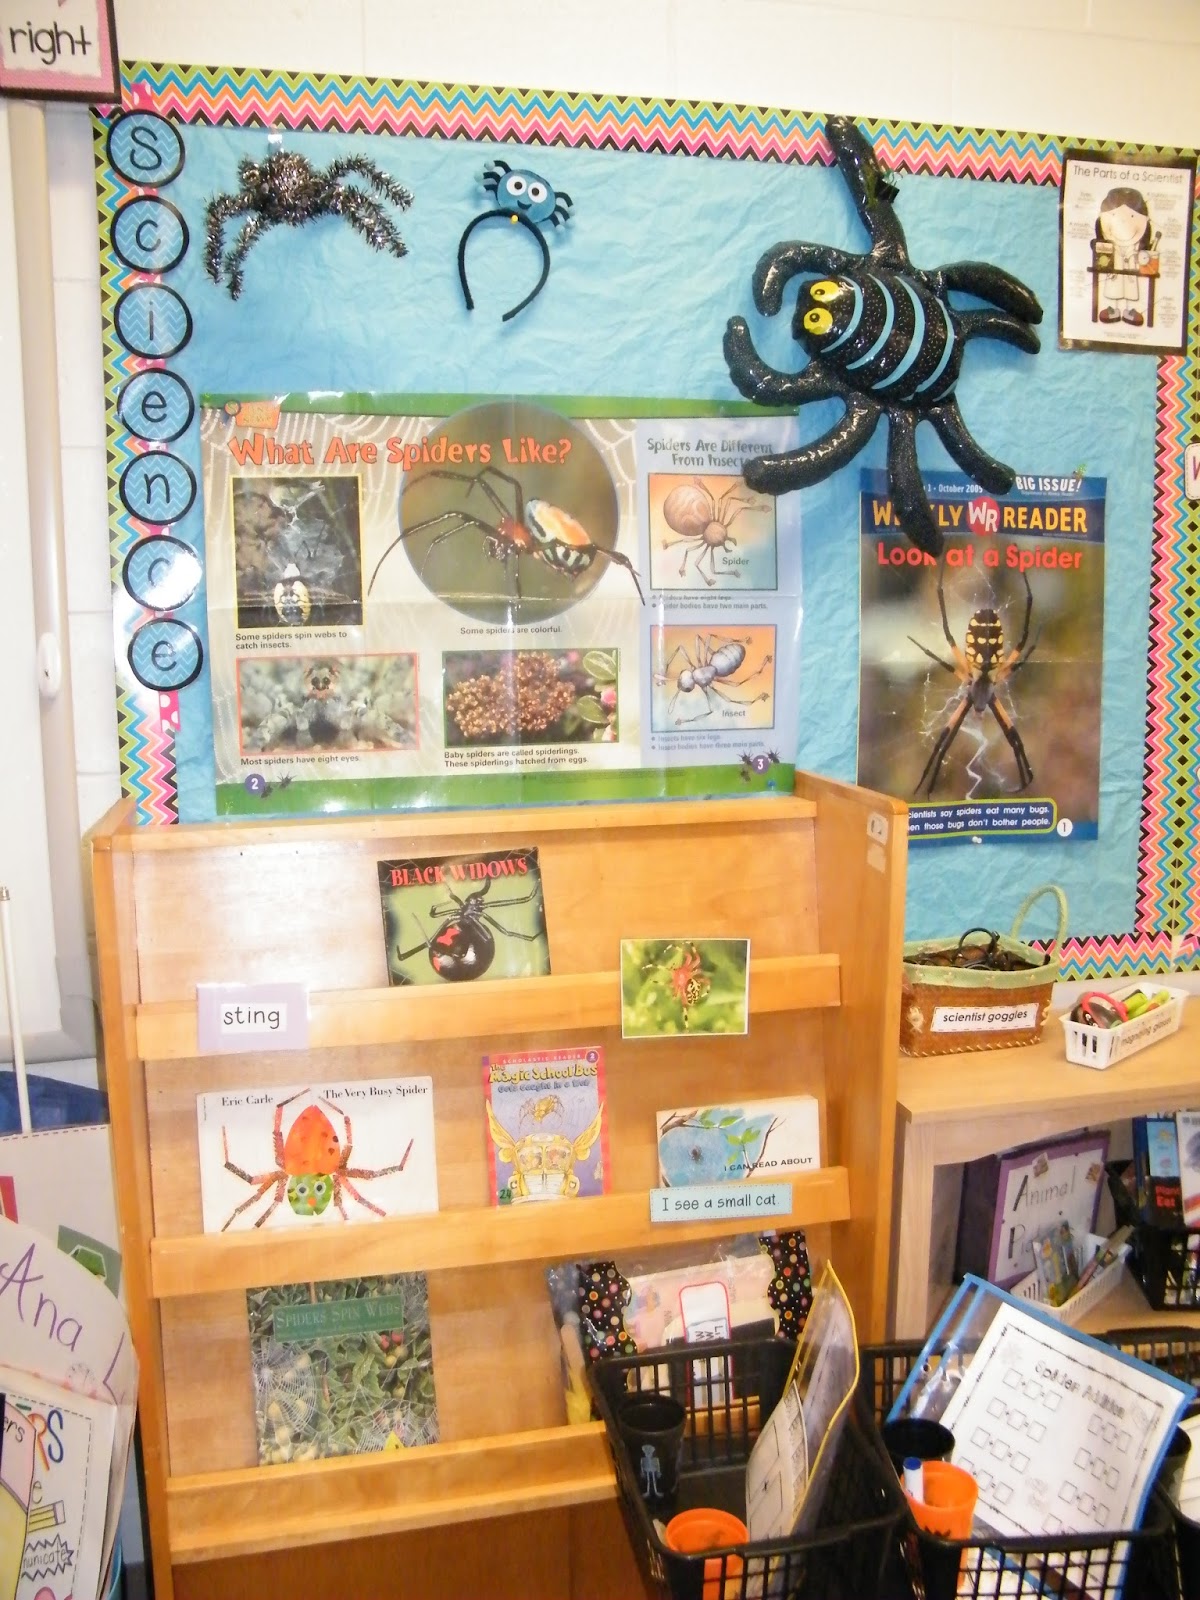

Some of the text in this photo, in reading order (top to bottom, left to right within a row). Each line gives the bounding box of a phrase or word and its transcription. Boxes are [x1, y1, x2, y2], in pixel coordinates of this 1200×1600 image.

[9, 21, 91, 65] right
[1074, 165, 1183, 184] The Parts of a Scientist
[227, 433, 572, 472] What Are Spiders Like?
[647, 438, 774, 454] Spiders Are Different
[672, 454, 704, 467] From
[938, 484, 964, 493] October
[1015, 476, 1082, 492] BIG ISSUE!
[873, 500, 1088, 533] WLY WR READER
[722, 556, 750, 566] Spider
[946, 544, 974, 568] at
[983, 550, 999, 568] a
[1006, 545, 1082, 573] Spider
[235, 630, 348, 641] Some spiders spin webs to
[235, 641, 292, 650] catch insects.
[240, 758, 262, 766] Most
[264, 756, 294, 766] spiders
[296, 756, 316, 764] have
[318, 755, 339, 764] eight
[444, 751, 464, 760] Baby
[466, 750, 495, 759] spiders
[512, 749, 534, 757] called
[536, 748, 580, 757] spiderlings.
[444, 760, 468, 768] These
[470, 758, 514, 768] spiderlings
[515, 758, 546, 766] hatched
[548, 757, 567, 765] from
[757, 758, 764, 770] 3
[251, 778, 259, 790] 2
[908, 806, 1050, 819] cientists say spiders eat many bugs.
[924, 822, 944, 830] those
[947, 820, 965, 830] bugs
[968, 819, 988, 828] don't
[992, 818, 1018, 827] bother
[1021, 817, 1051, 827] people.
[1062, 822, 1067, 833] 1
[390, 858, 528, 887] BLACK WIDOWS
[223, 1006, 280, 1030] sting
[943, 1009, 1028, 1024] scientist goggles
[502, 1055, 549, 1065] SCHOLASTIC
[489, 1063, 599, 1085] Magic School Bus
[323, 1085, 428, 1099] The Very Busy Spider
[222, 1094, 274, 1106] Eric Carle
[729, 1164, 749, 1172] CAN
[752, 1161, 778, 1169] READ
[780, 1157, 813, 1166] ABOUT
[1013, 1165, 1076, 1212] Animal
[662, 1197, 669, 1211] I
[675, 1199, 699, 1211] see
[704, 1199, 712, 1208] a
[717, 1194, 751, 1208] small
[276, 1301, 400, 1328] SPIDERS SPIN WEBS
